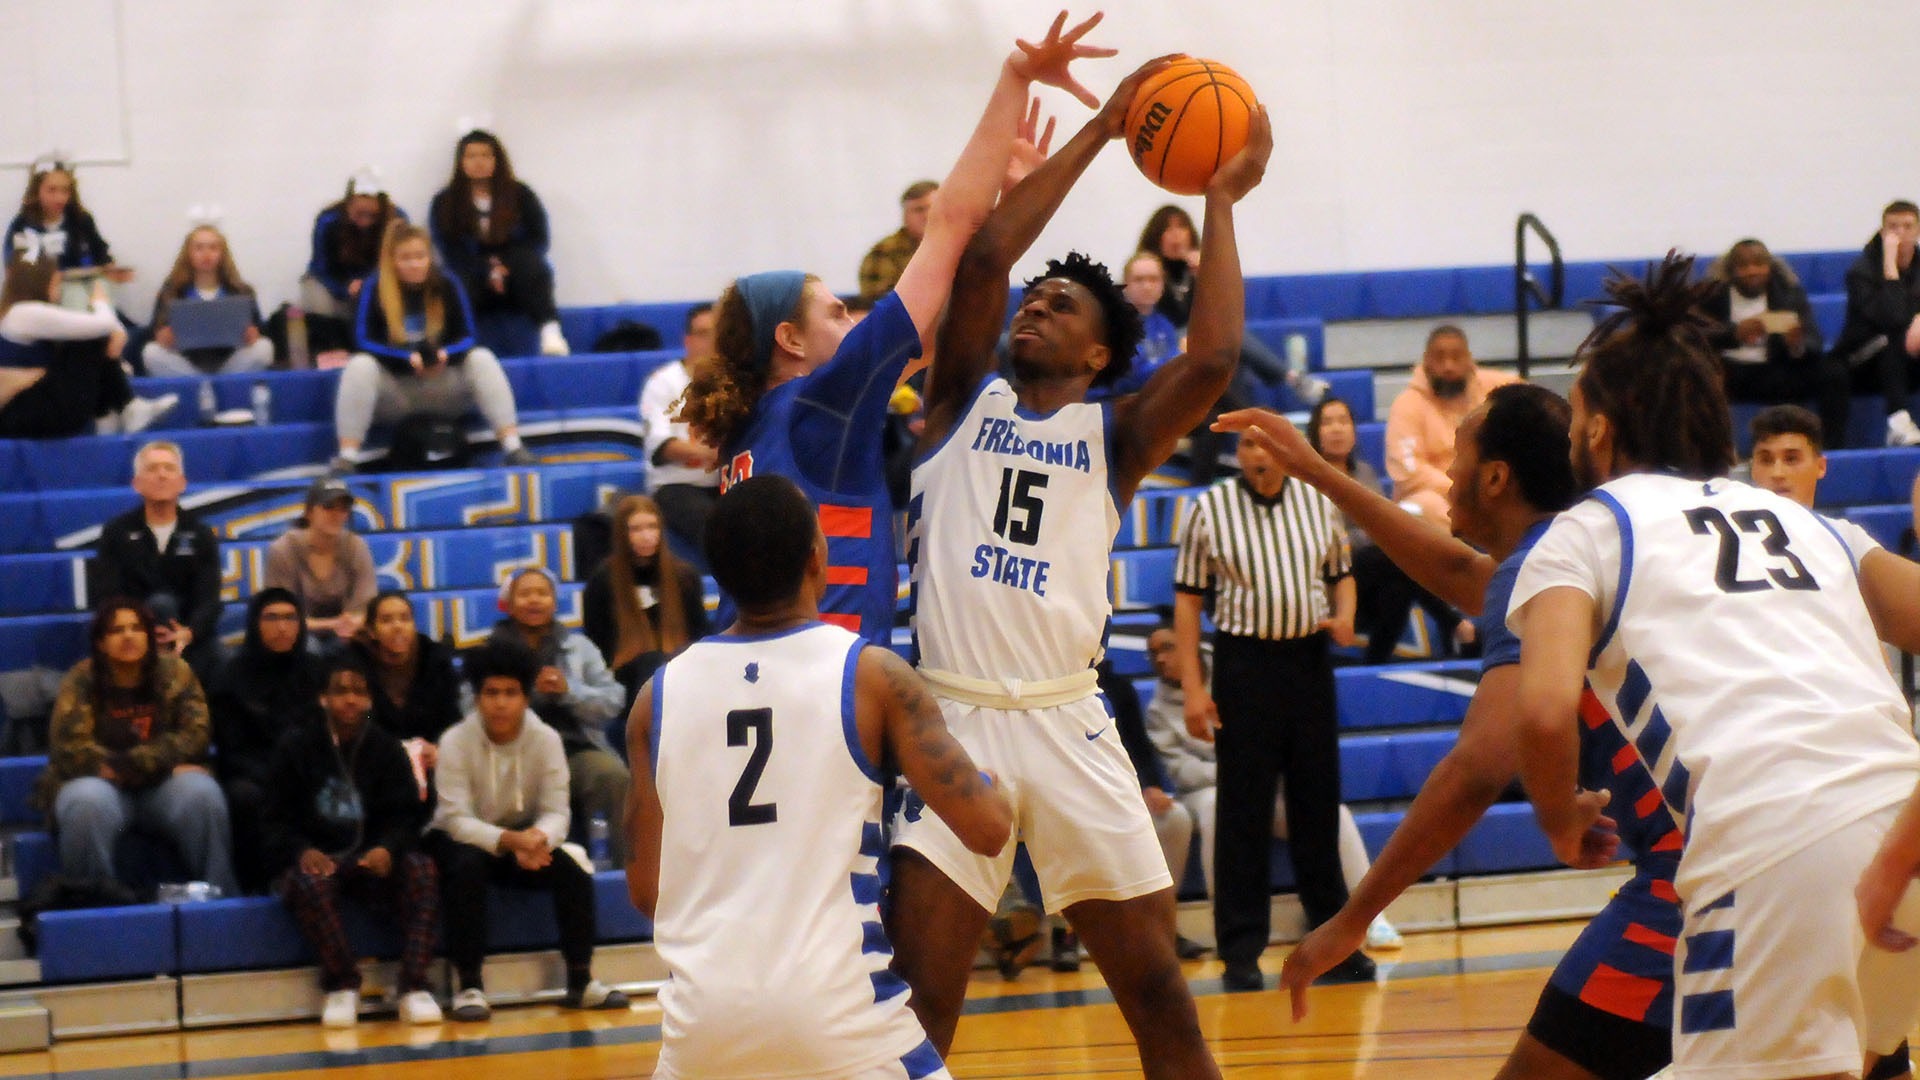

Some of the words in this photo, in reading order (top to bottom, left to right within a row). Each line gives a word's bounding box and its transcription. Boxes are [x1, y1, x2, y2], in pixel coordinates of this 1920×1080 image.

[971, 417, 1091, 474] FREDONIA
[993, 467, 1050, 547] 15
[970, 543, 1050, 597] STATE
[1681, 506, 1821, 594] 23
[726, 707, 778, 827] 2
